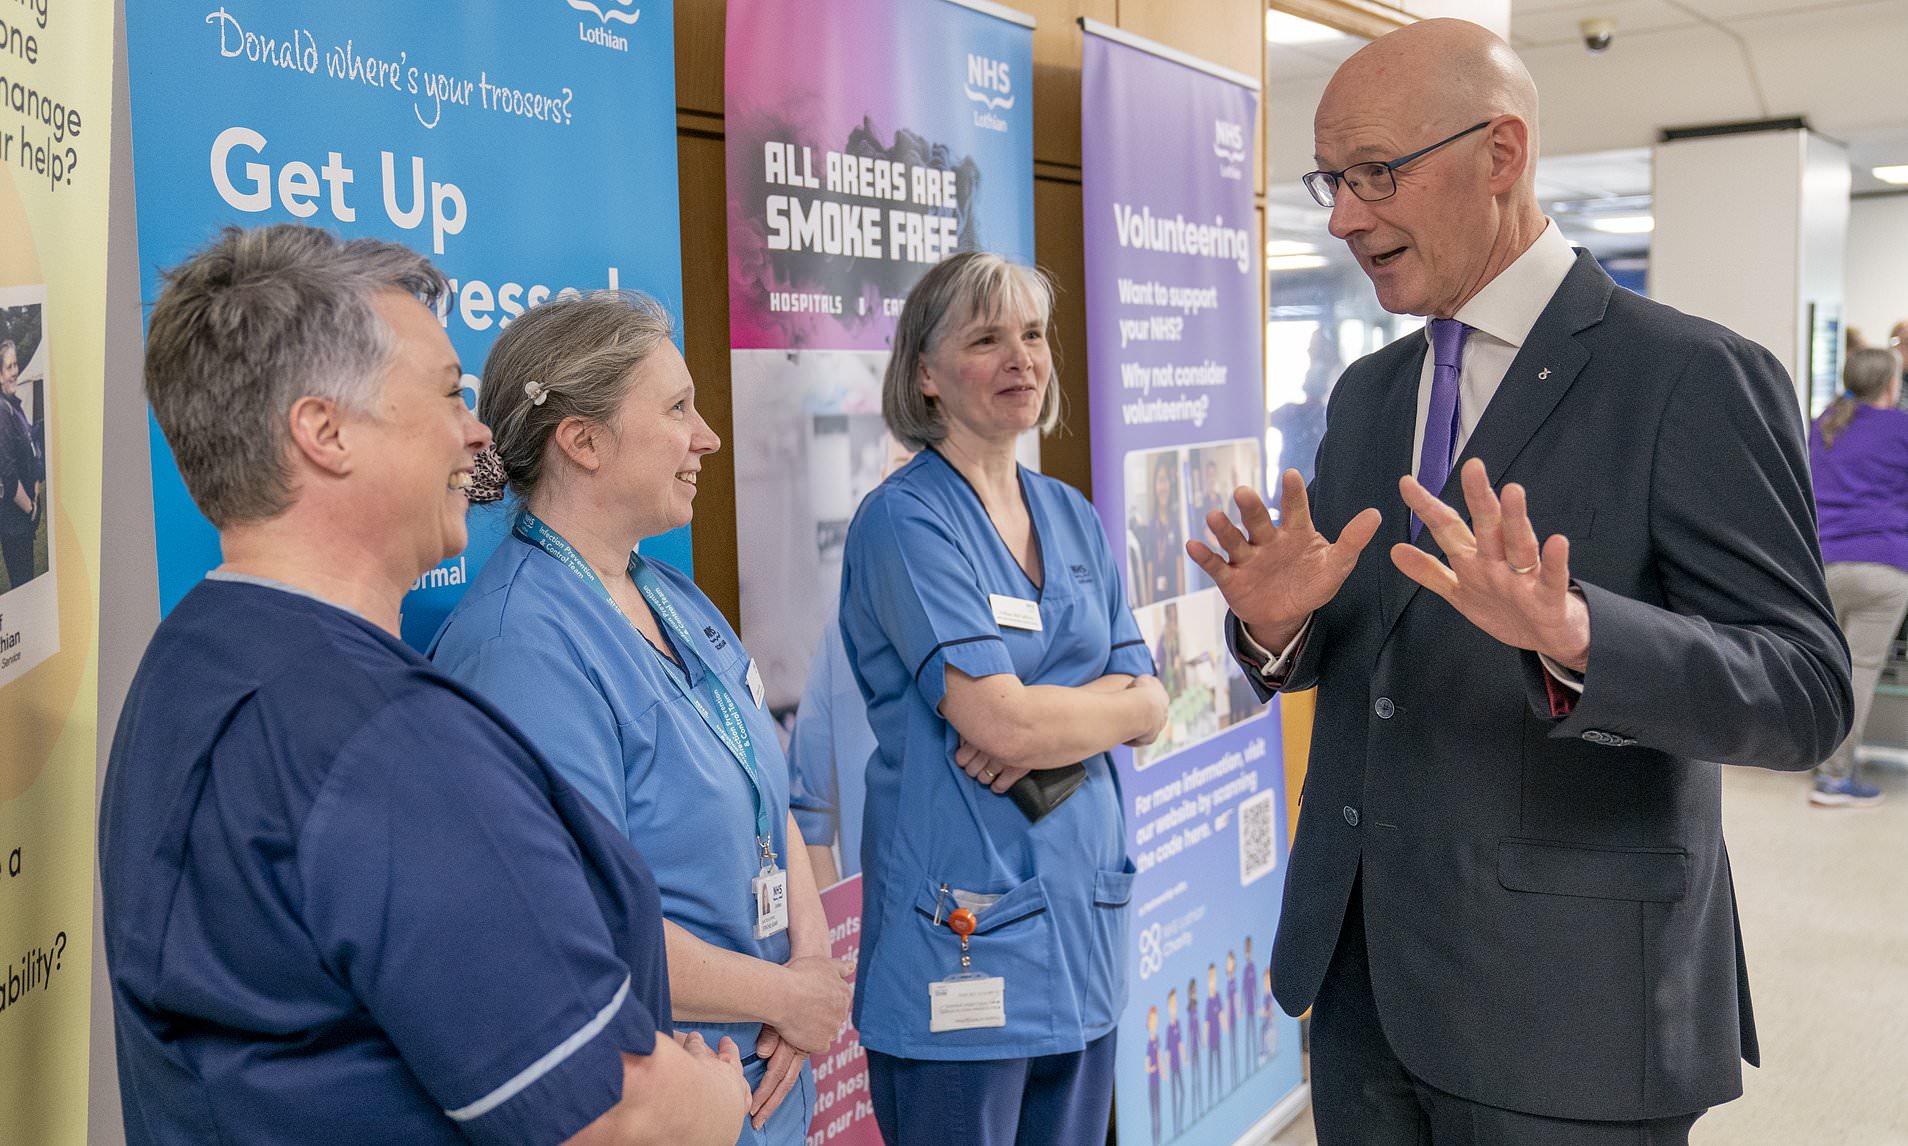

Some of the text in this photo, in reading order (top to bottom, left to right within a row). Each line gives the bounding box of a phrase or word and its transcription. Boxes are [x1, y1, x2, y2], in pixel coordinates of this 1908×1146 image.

[579, 21, 629, 52] Lothian
[205, 6, 573, 129] Donald where's your troosers?
[967, 53, 1011, 94] NHS
[21, 125, 78, 193] help?
[764, 141, 957, 209] ALL AREAS ARE
[210, 126, 468, 254] Get Up
[766, 194, 958, 263] SMOKE FREE
[1112, 202, 1250, 274] Volunteering
[769, 292, 843, 315] HOSPITALS
[1117, 278, 1218, 316] Want to support
[1119, 316, 1185, 349] your NHS?
[1120, 359, 1228, 396] Why not consider
[1121, 393, 1210, 428] volunteering?
[539, 526, 595, 581] Infection Prevention
[546, 543, 570, 564] Control
[567, 561, 584, 579] Team
[713, 689, 733, 727] Prevention
[723, 692, 736, 712] Team
[731, 711, 748, 740] Control
[9, 847, 21, 877] a
[827, 1109, 853, 1139] our
